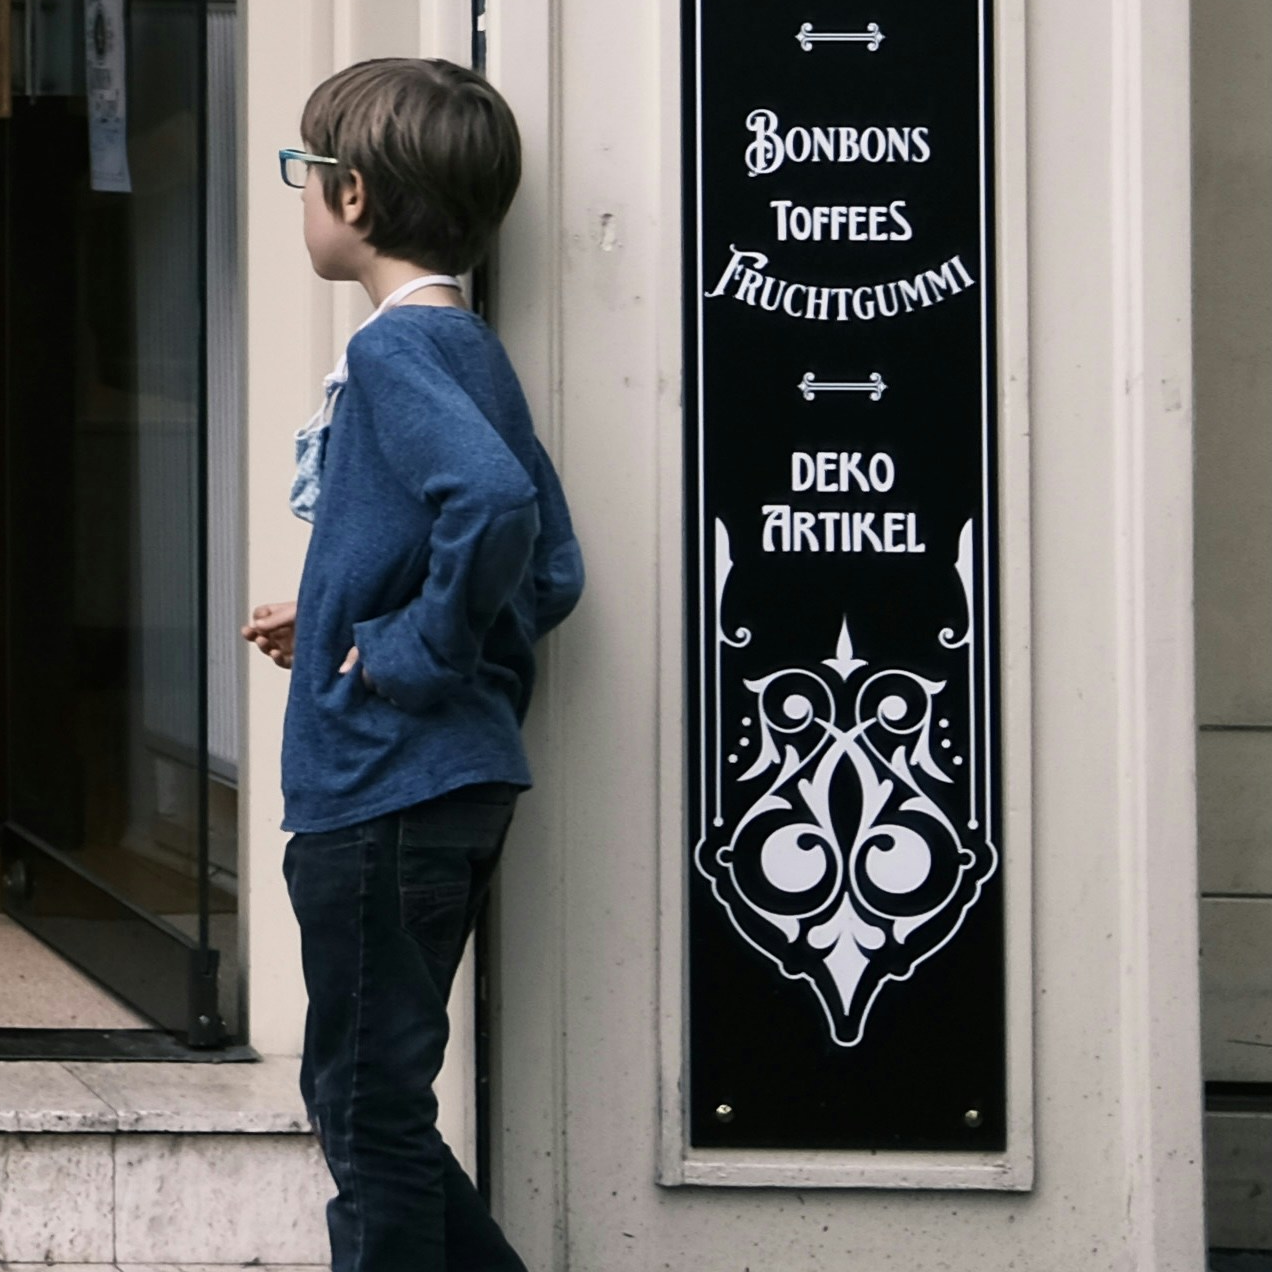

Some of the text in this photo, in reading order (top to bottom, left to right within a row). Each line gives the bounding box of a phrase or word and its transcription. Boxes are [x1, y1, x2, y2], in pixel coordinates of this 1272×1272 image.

[745, 108, 931, 177] BONBONS
[770, 200, 913, 241] TOFFEES
[705, 243, 976, 321] FRUCHTGUMMI
[791, 452, 895, 493] DEKO
[761, 504, 926, 553] ARTIKEL
